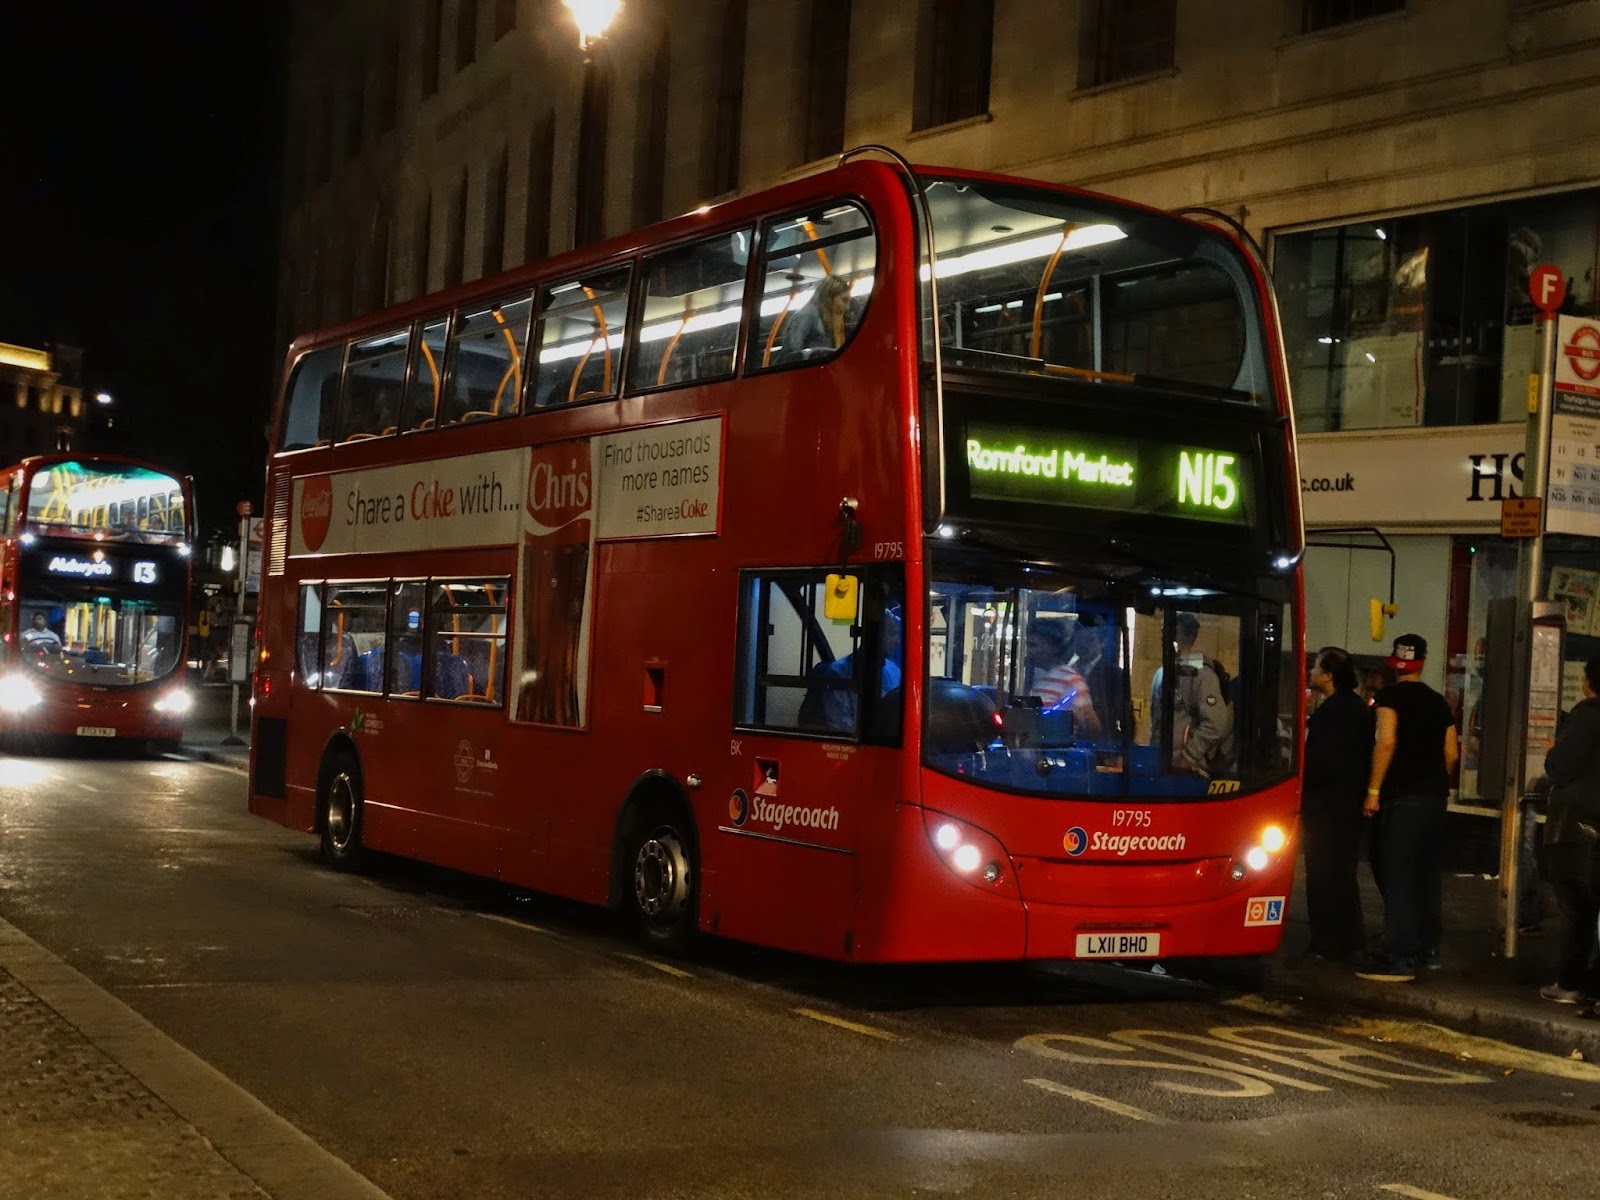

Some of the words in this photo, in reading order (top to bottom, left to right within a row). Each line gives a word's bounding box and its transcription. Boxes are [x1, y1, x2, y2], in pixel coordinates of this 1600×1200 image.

[1542, 274, 1557, 303] F
[604, 442, 633, 468] Find
[637, 434, 711, 462] thousands
[967, 440, 1057, 477] Romford
[1063, 451, 1133, 486] Market
[529, 459, 590, 511] Chris
[622, 470, 658, 492] more
[662, 464, 709, 487] names
[1178, 452, 1236, 509] N15
[346, 490, 391, 526] Share
[394, 494, 405, 522] a
[875, 541, 903, 559] 19795
[730, 740, 742, 756] BK
[751, 797, 839, 831] Stagecoach
[1112, 810, 1152, 827] 19795
[1090, 831, 1186, 855] Stagecoach
[1087, 936, 1115, 953] LX11
